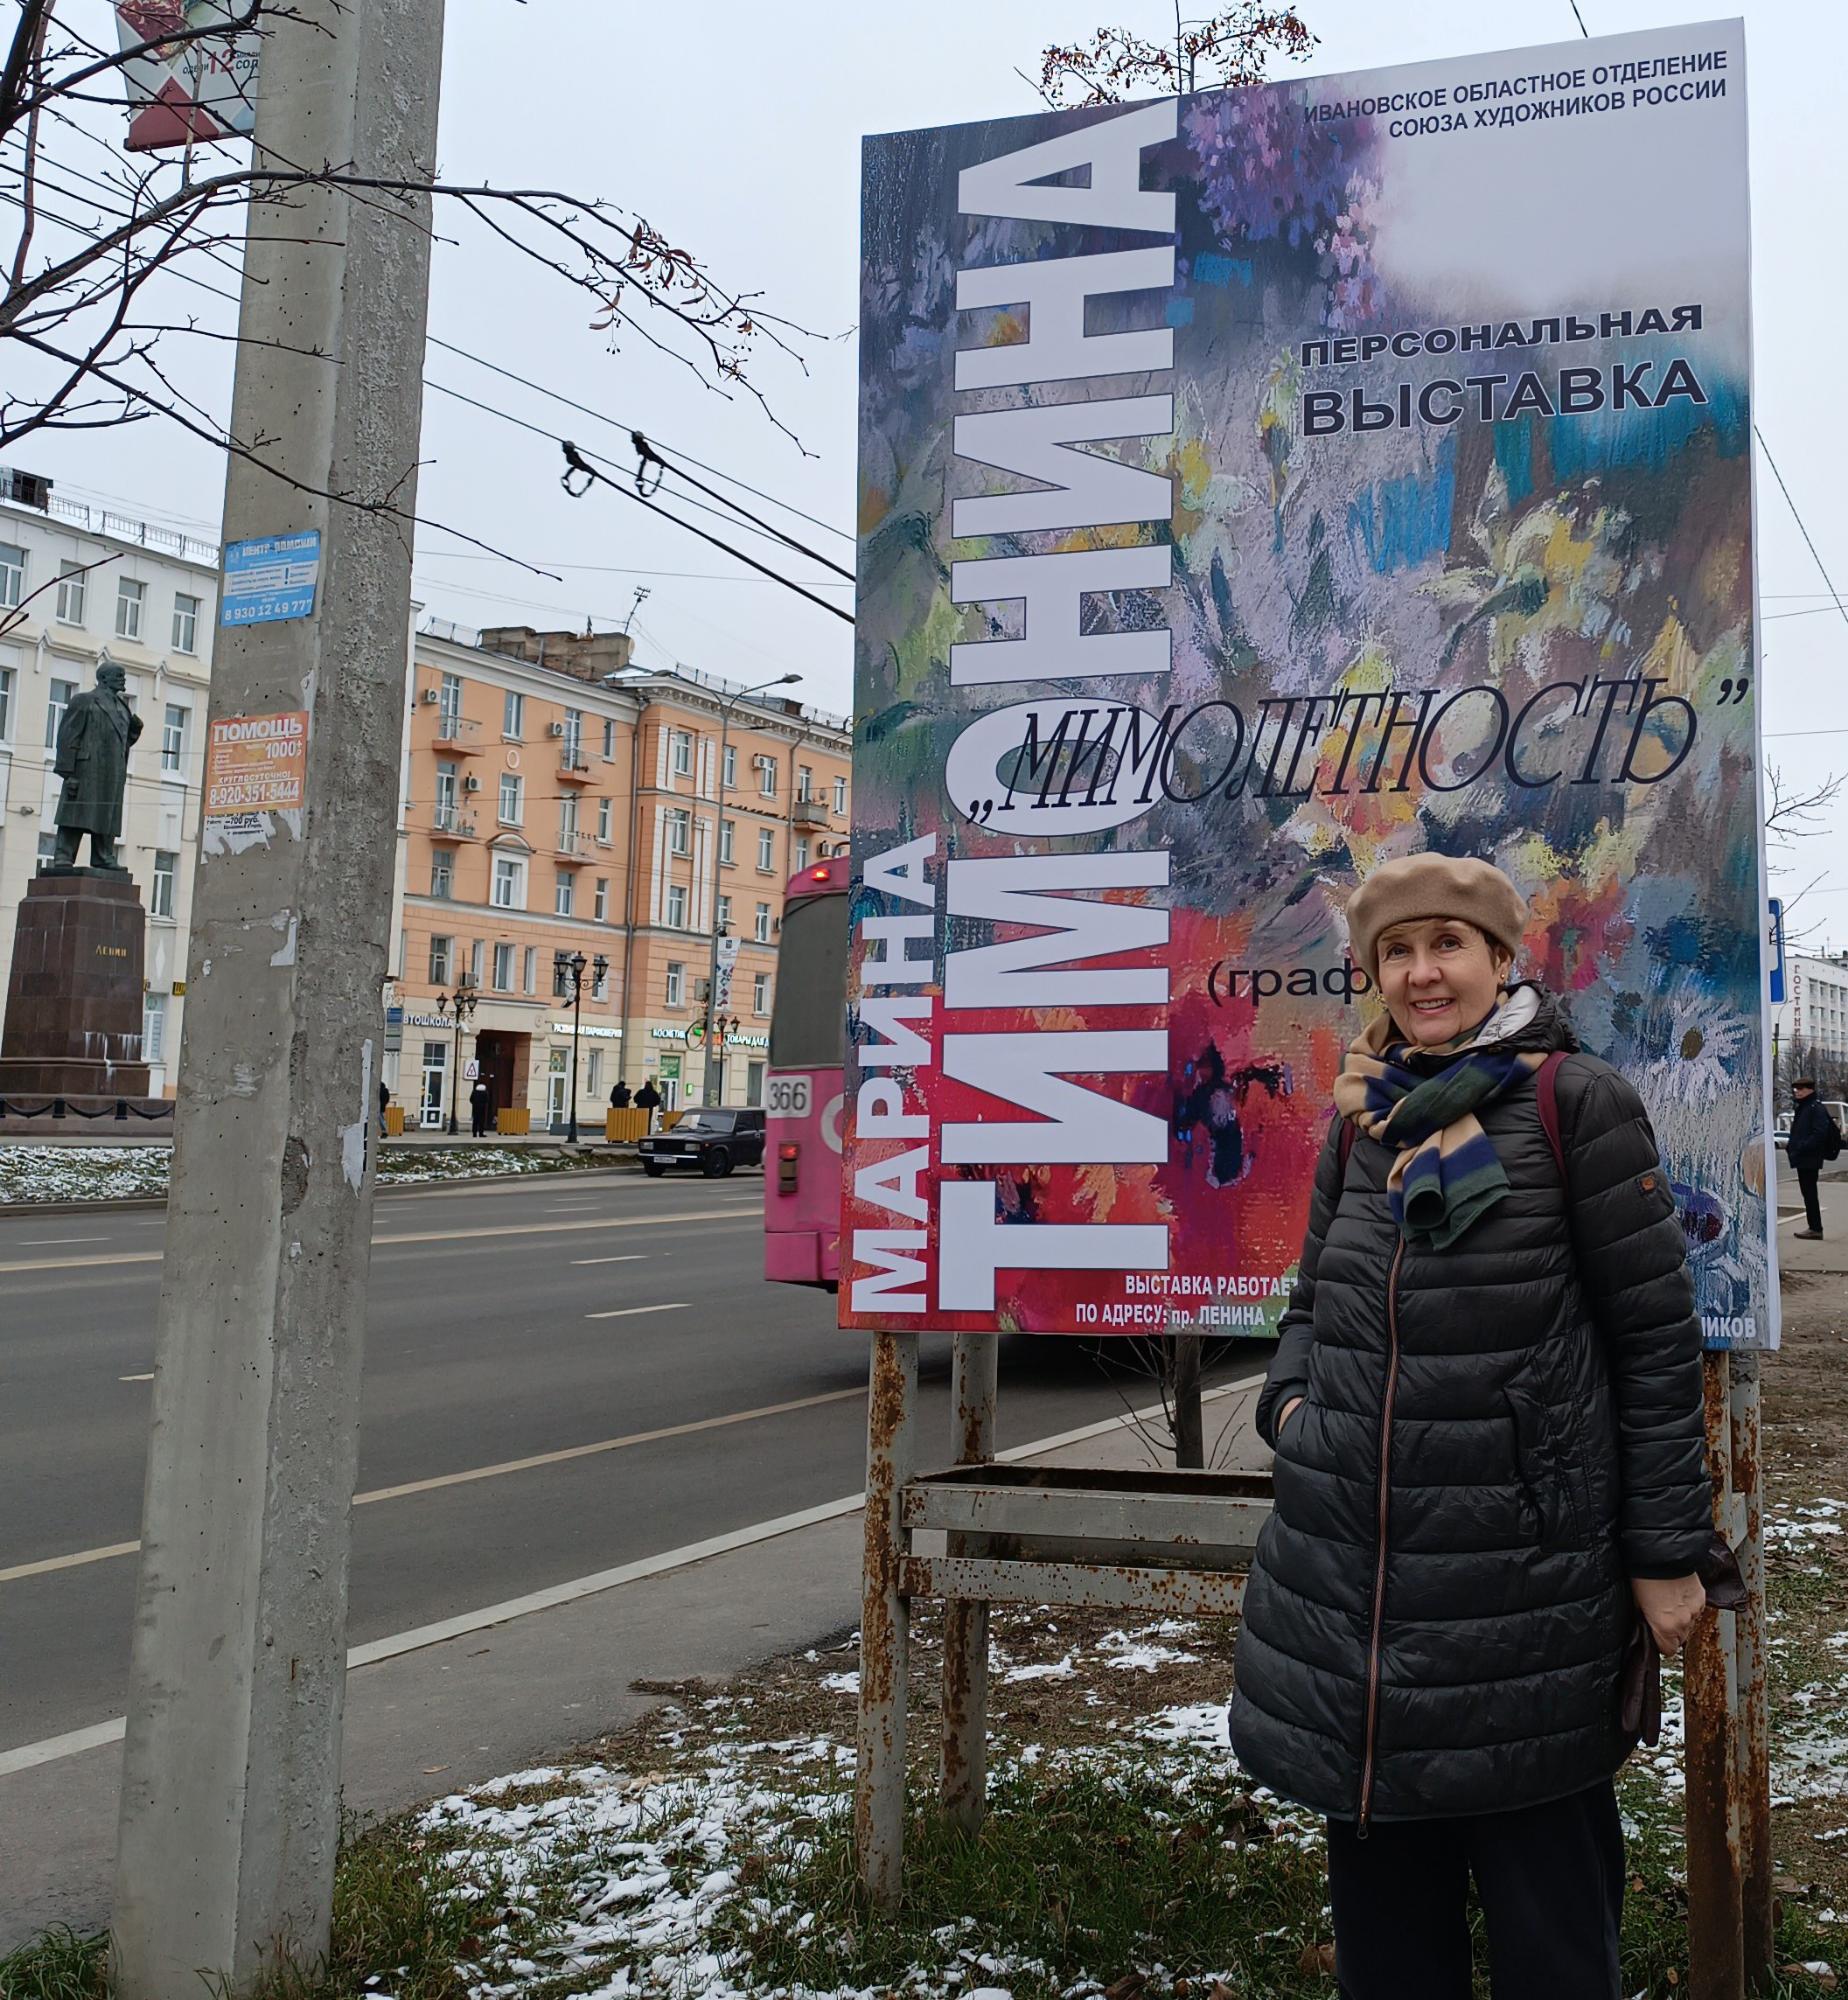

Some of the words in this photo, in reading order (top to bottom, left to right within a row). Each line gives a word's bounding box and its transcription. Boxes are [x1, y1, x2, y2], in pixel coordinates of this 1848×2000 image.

[1302, 87, 1447, 123] ИВАНОВСКОЕ
[1453, 69, 1586, 104] ОБЛАСТНОЕ
[1592, 50, 1728, 87] ОТДЕЛЕНИЕ
[1389, 108, 1468, 138] СОЮЗА
[1473, 90, 1626, 127] ХУДОЖНИКОВ
[1632, 78, 1727, 107] РОССИИ
[1300, 303, 1704, 368] ПЕРСОНАЛЬНАЯ
[1301, 357, 1709, 438] ВЫСТАВКА
[224, 609, 232, 620] 8
[234, 606, 256, 620] 930
[258, 603, 273, 617] 12
[274, 601, 289, 614] 49
[939, 97, 1179, 1311] ТИМОНИНА
[213, 718, 303, 742] ПОМОЩЬ
[209, 780, 300, 806] 8-920-351-5444
[1207, 957, 1374, 1008] (граф
[1792, 964, 1802, 1048] ГОСТИНИЦ
[403, 1014, 453, 1029] ВТОШКОЛА
[769, 1081, 807, 1111] 366
[851, 831, 937, 1314] МАРИНА
[1125, 1275, 1213, 1296] ВЫСТАВКА
[1076, 1303, 1098, 1323] ПО
[1101, 1304, 1168, 1326] АДРЕСУ:
[1171, 1309, 1194, 1328] пр.
[1199, 1305, 1265, 1326] ЛЕНИНА
